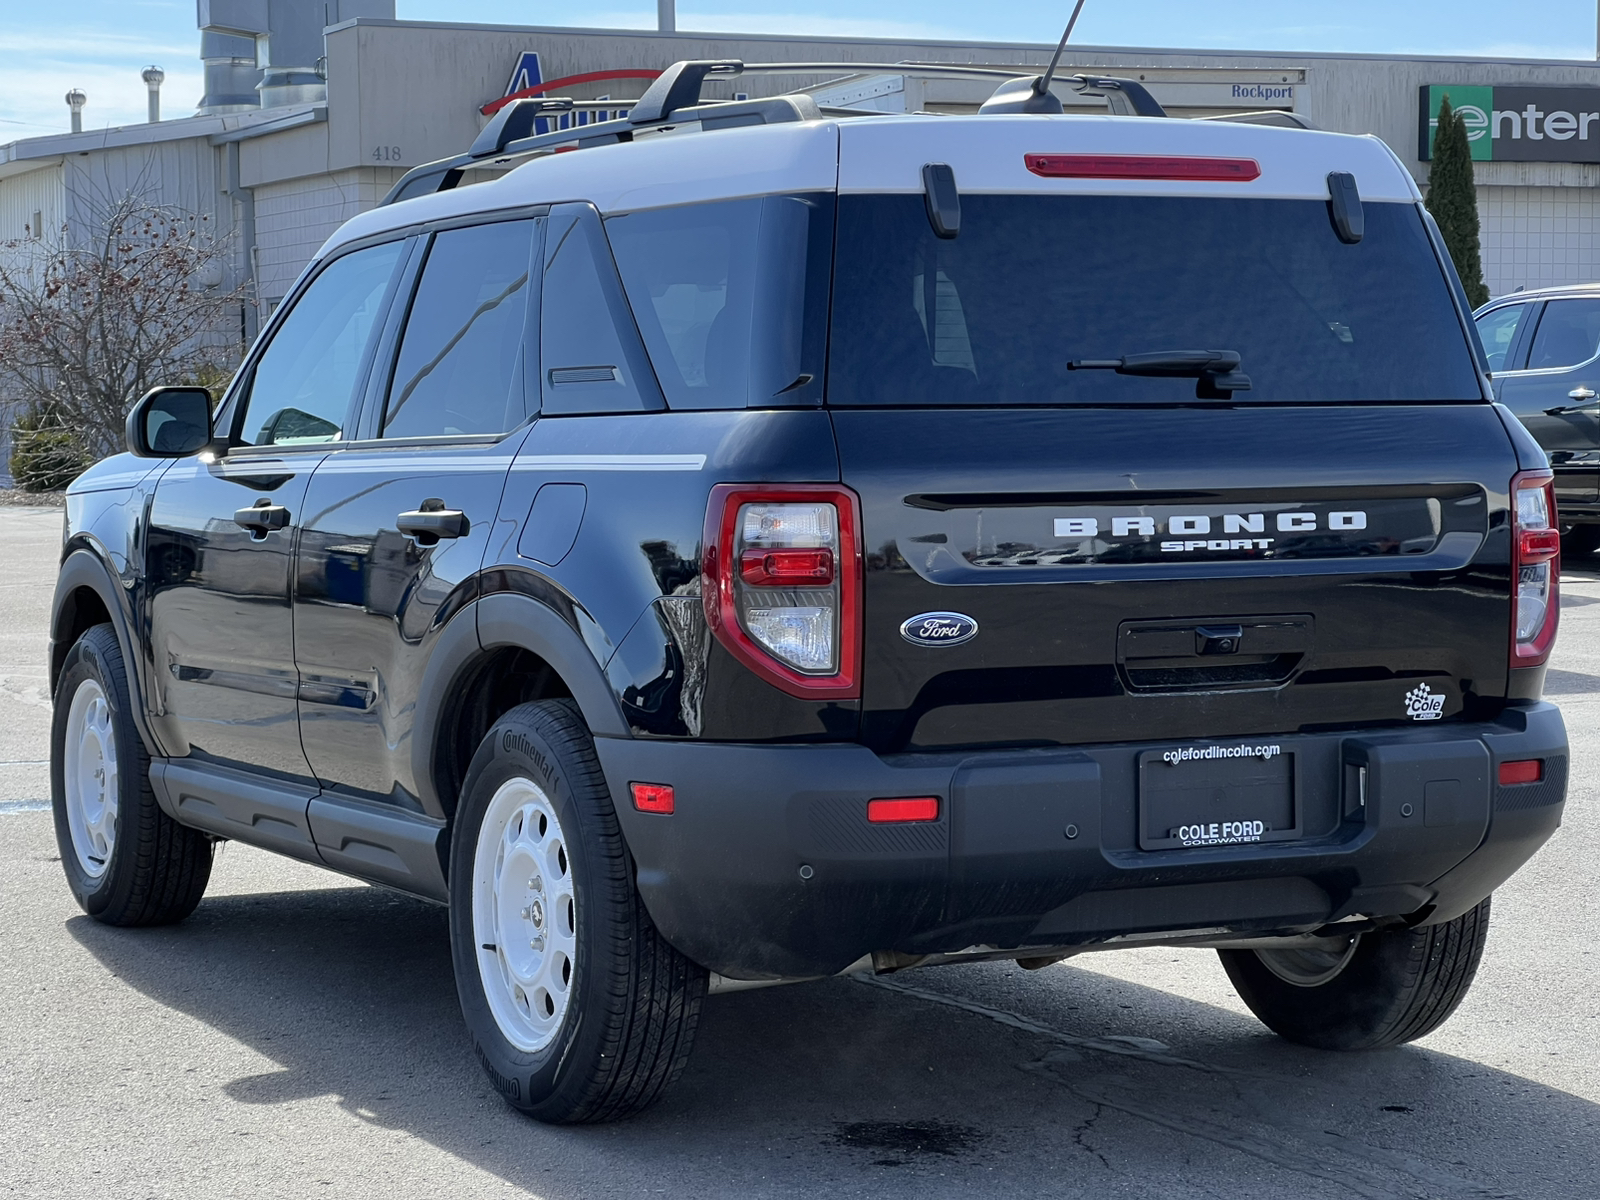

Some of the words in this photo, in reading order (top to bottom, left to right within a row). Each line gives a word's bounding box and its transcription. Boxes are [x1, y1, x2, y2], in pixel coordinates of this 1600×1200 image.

[1231, 84, 1293, 101] Rockport
[372, 146, 401, 161] 418
[1053, 511, 1367, 537] BRONCO
[1160, 538, 1275, 552] SPORT
[920, 619, 961, 637] Ford
[1411, 698, 1441, 712] Cole
[502, 729, 554, 783] Continental
[1163, 744, 1281, 763] colefordlincoln.com
[1179, 824, 1219, 840] COLE
[1222, 820, 1264, 837] FORD
[1183, 835, 1261, 846] COLDWATER
